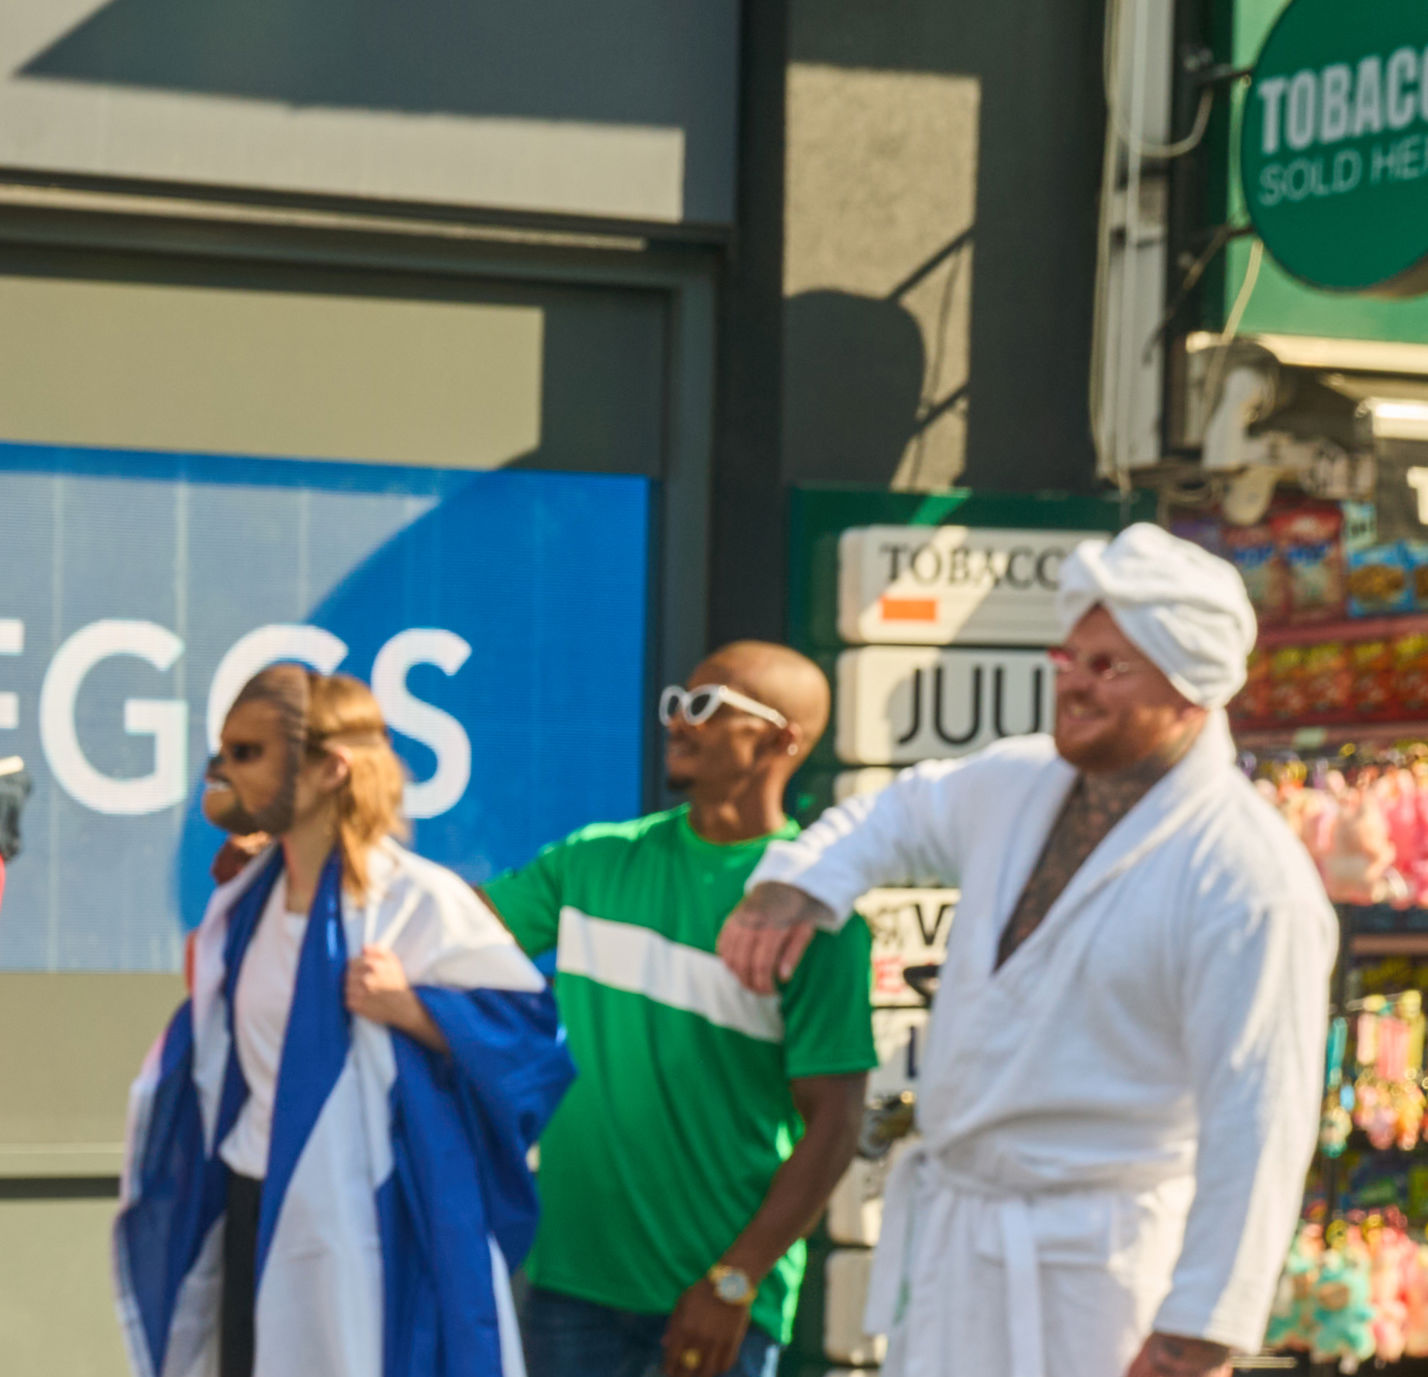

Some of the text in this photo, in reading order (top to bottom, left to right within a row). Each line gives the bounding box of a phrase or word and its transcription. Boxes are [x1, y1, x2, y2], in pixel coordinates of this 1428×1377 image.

[1257, 44, 1428, 156] TOBAC
[1259, 133, 1428, 207] SOLD HE
[877, 541, 1068, 591] TOBACC
[897, 665, 1044, 746] JUU
